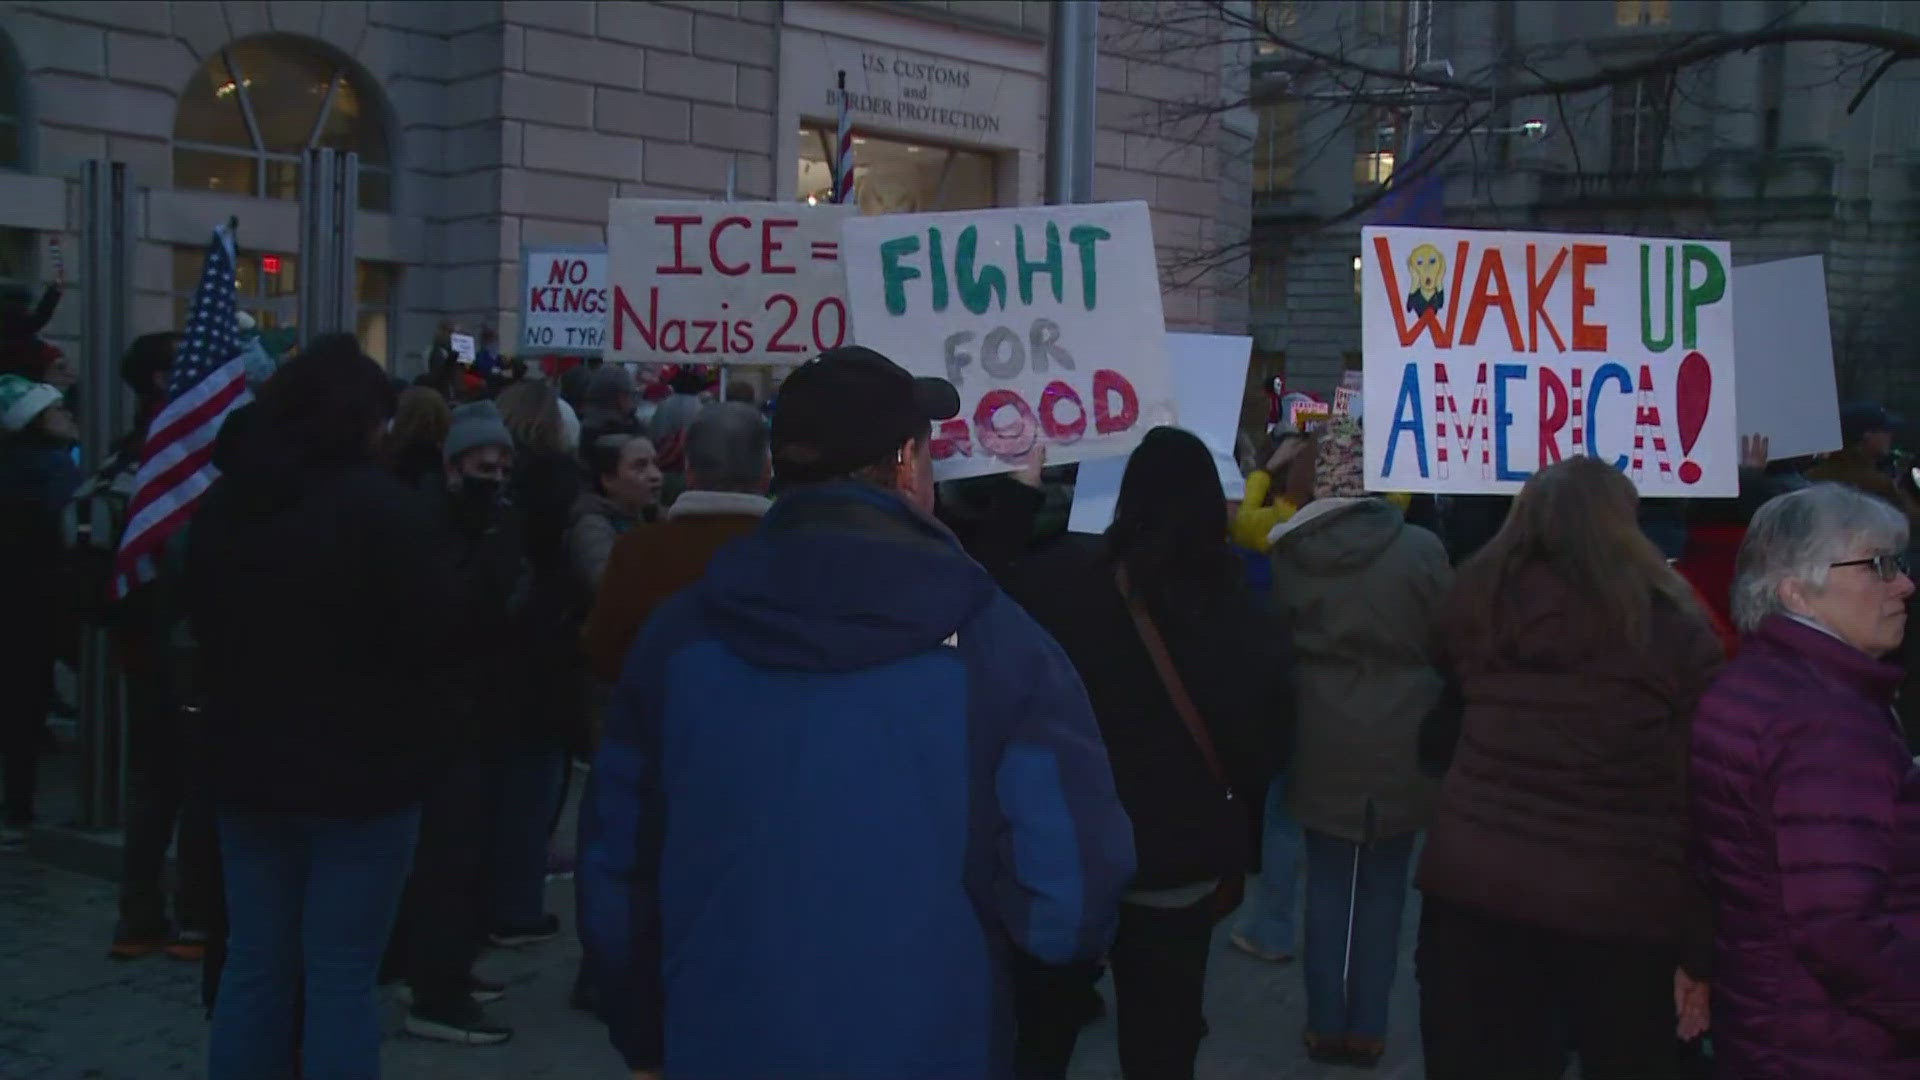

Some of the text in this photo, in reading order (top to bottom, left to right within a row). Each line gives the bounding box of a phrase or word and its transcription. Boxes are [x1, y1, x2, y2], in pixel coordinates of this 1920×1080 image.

[862, 52, 970, 88] U.S. CUSTOMS
[826, 88, 999, 132] BRDER PROTECTION
[903, 84, 928, 101] and
[548, 259, 588, 285] NO
[881, 220, 1111, 316] FIGHT
[531, 286, 607, 313] KINGS
[1373, 237, 1726, 353] WAKE UP
[527, 326, 553, 345] NO
[613, 286, 847, 354] Nazis 2.0
[945, 318, 1075, 386] FOR
[1381, 351, 1712, 484] AMERICA!
